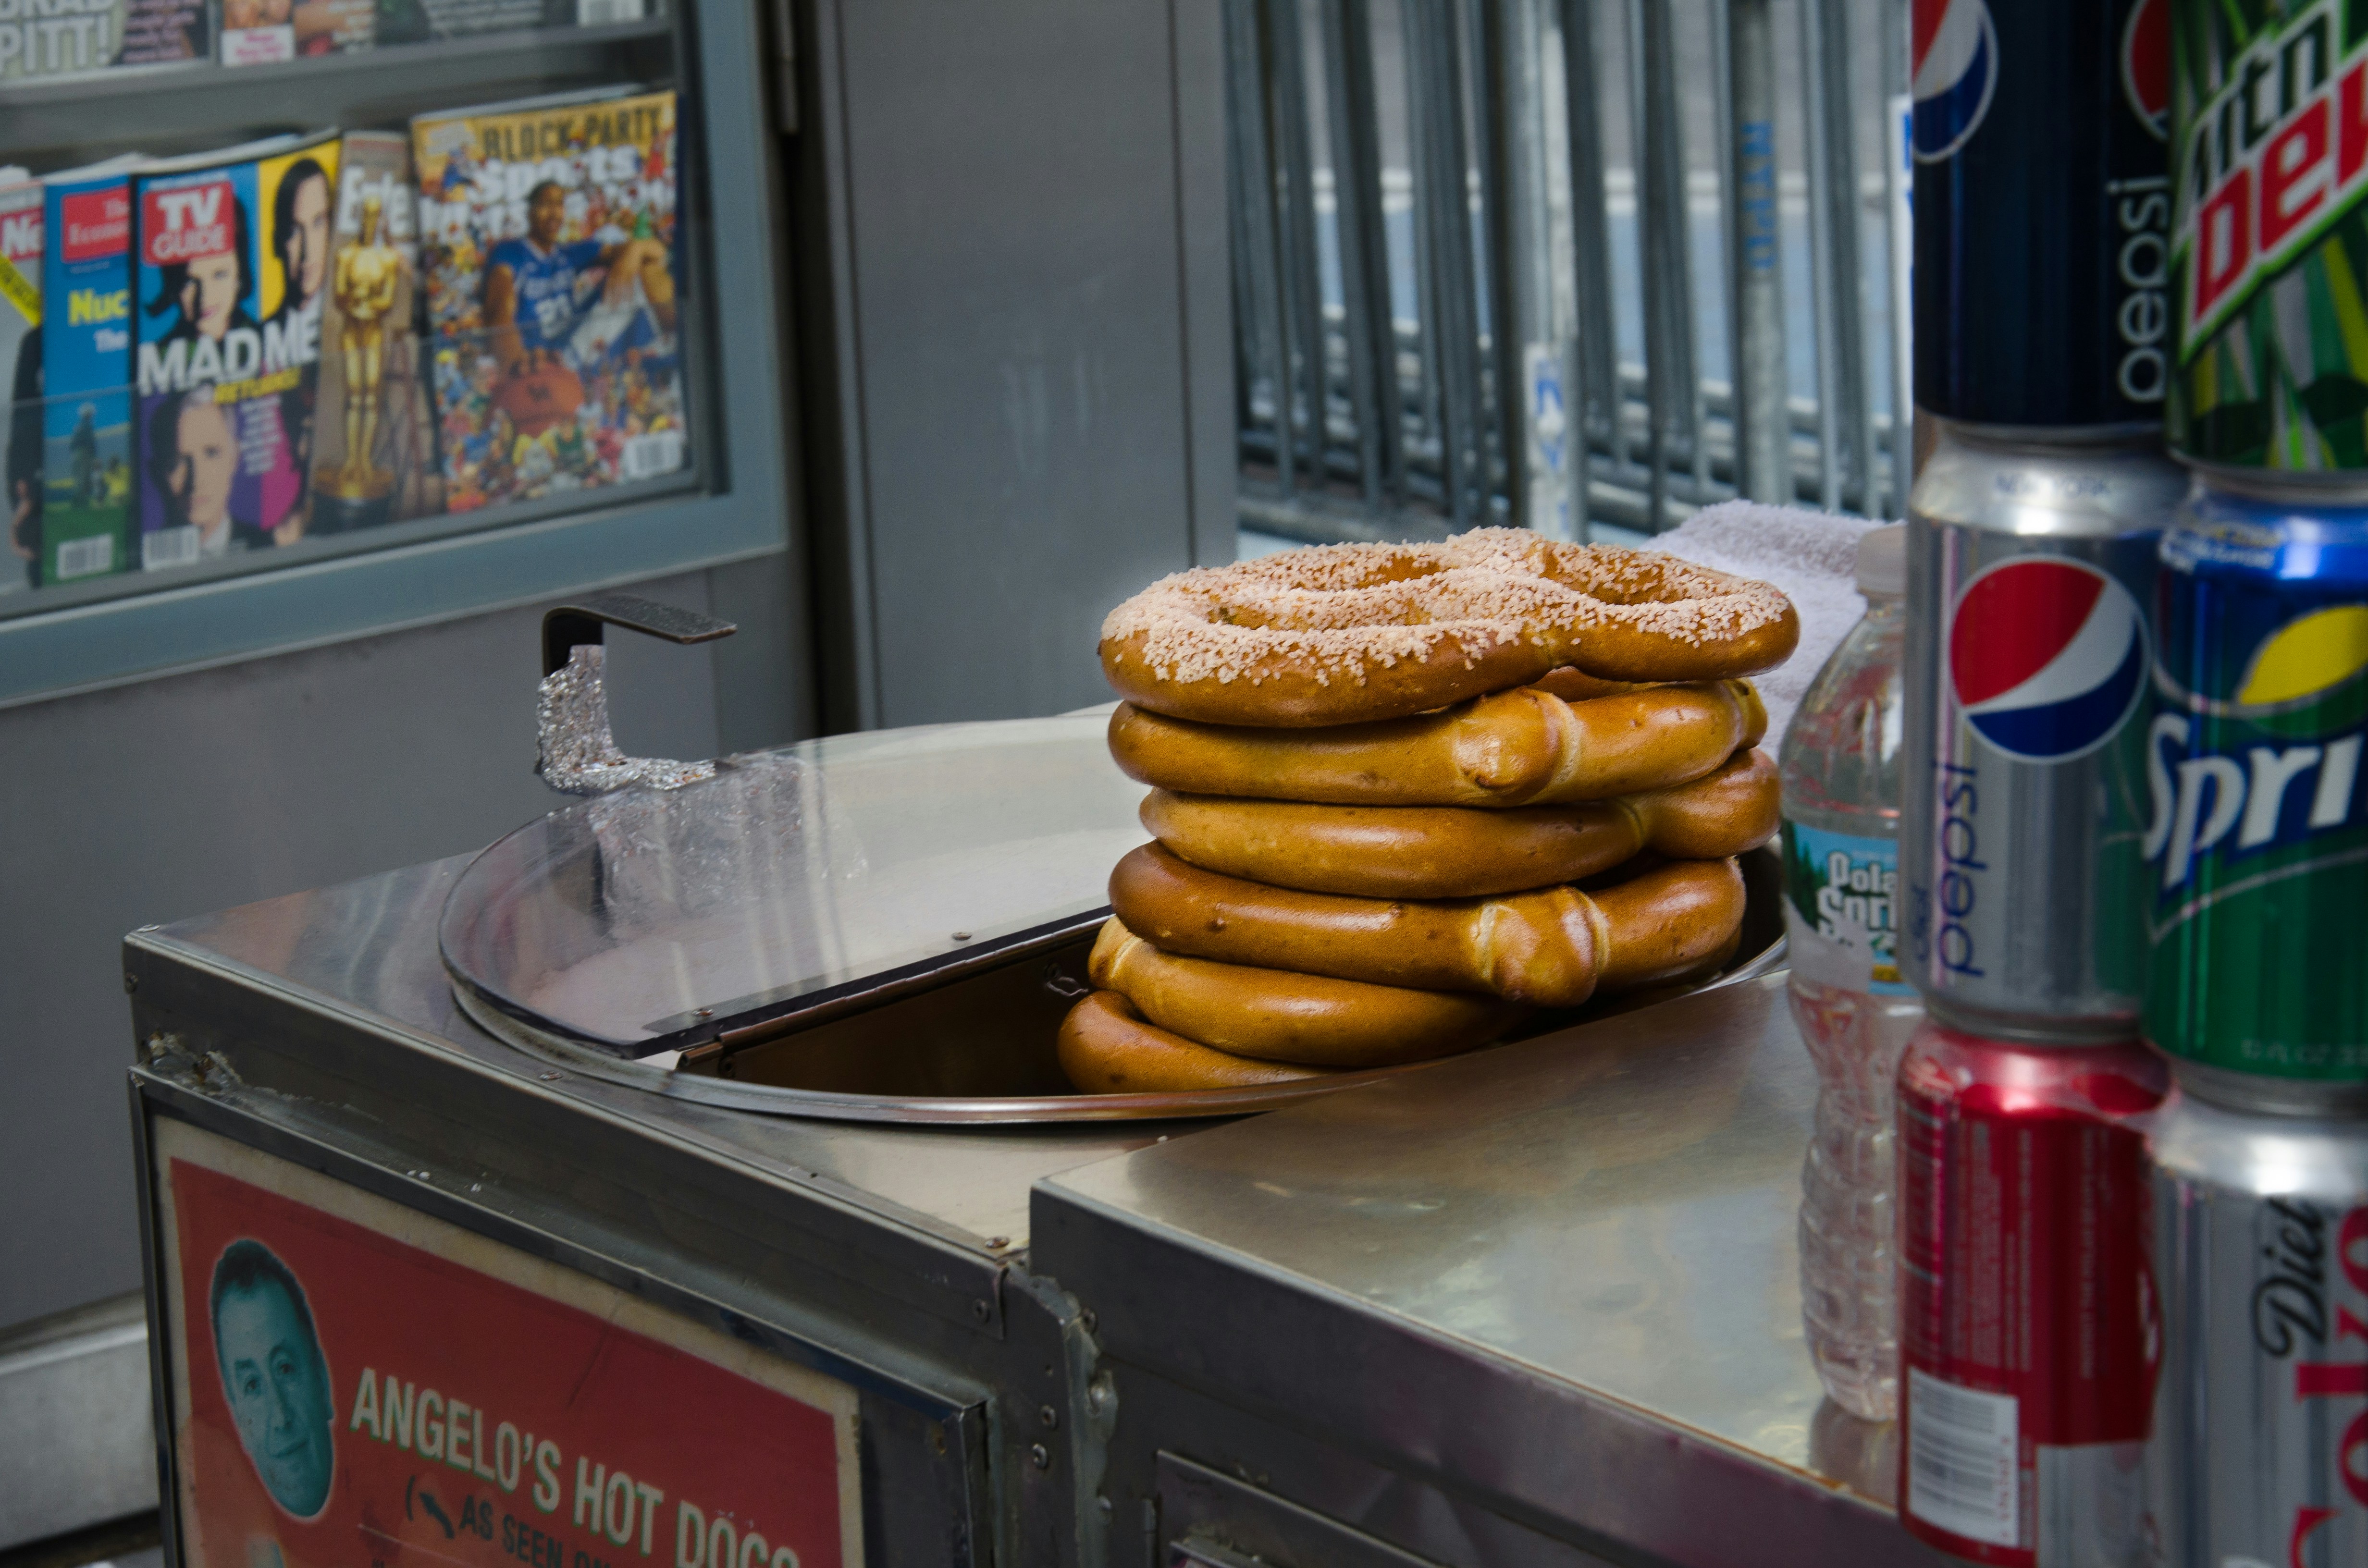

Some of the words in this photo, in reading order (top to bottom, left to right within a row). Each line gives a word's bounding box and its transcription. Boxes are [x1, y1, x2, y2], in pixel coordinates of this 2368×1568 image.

[482, 119, 575, 161] BLOCK
[584, 104, 664, 146] PARTY
[151, 223, 228, 258] GUIDE
[157, 185, 222, 231] TV
[137, 329, 260, 398] MAD
[1935, 760, 1987, 977] pepsi
[2251, 1197, 2327, 1359] Diet
[349, 1367, 562, 1514] ANGELO'S
[572, 1456, 665, 1558] HOT
[459, 1494, 493, 1541] AS
[502, 1514, 563, 1568] SEEN
